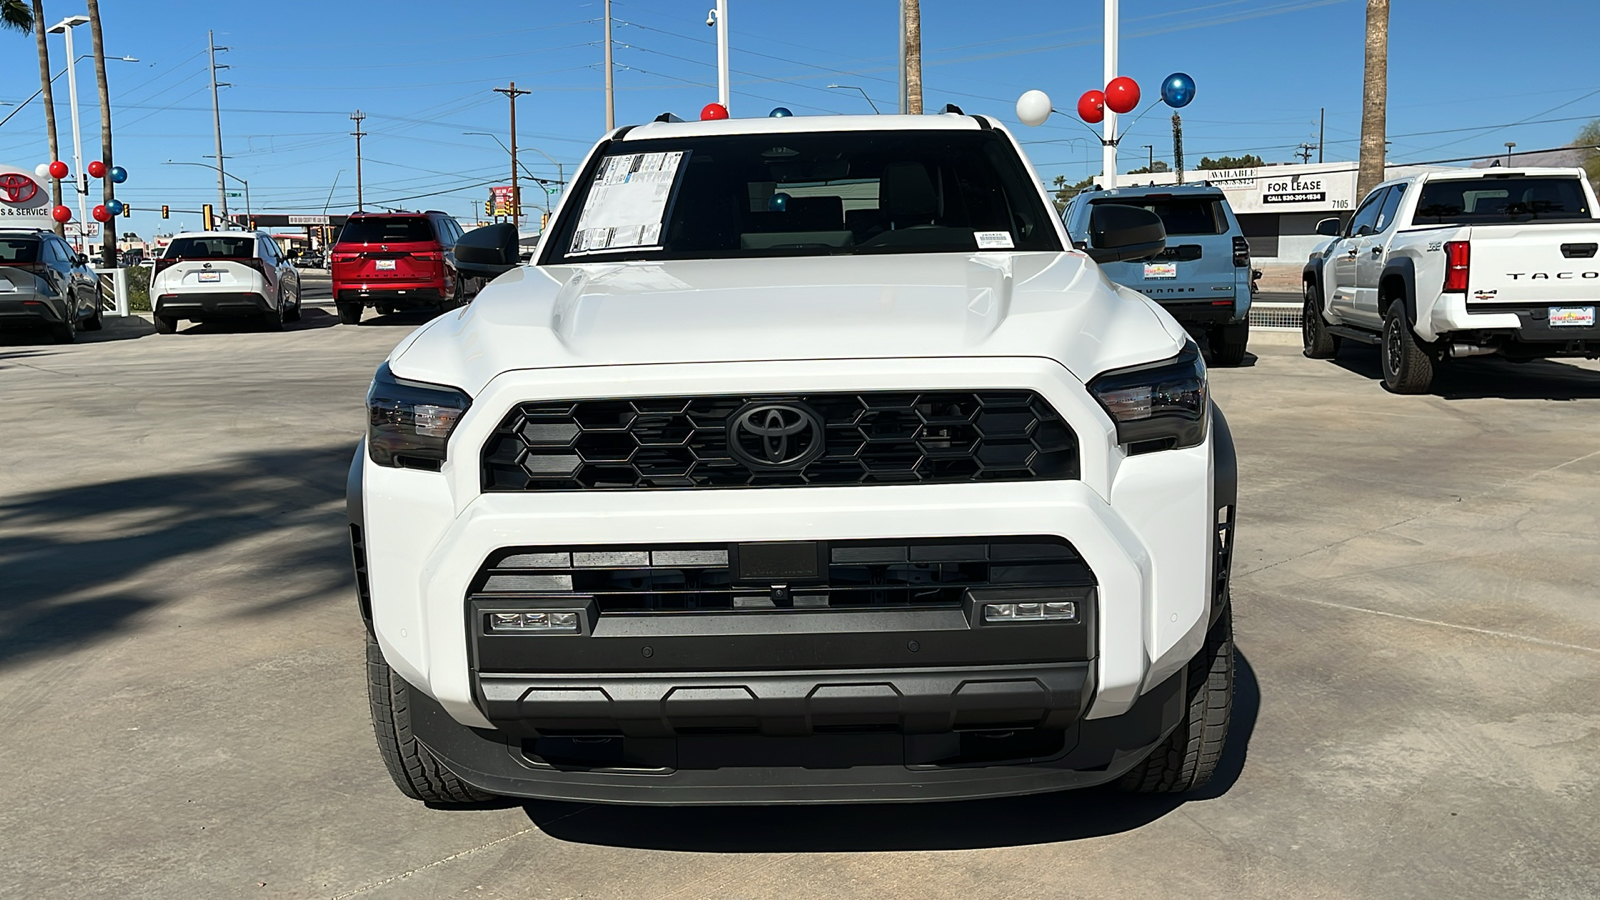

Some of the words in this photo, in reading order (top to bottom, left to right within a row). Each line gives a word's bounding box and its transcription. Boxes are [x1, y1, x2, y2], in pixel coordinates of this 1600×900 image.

[1210, 169, 1256, 179] AVAILABLE
[1267, 182, 1288, 192] FOR
[1291, 180, 1321, 191] LEASE
[1332, 200, 1349, 209] 7105
[16, 208, 48, 216] SERVICE
[1506, 272, 1599, 280] TACO
